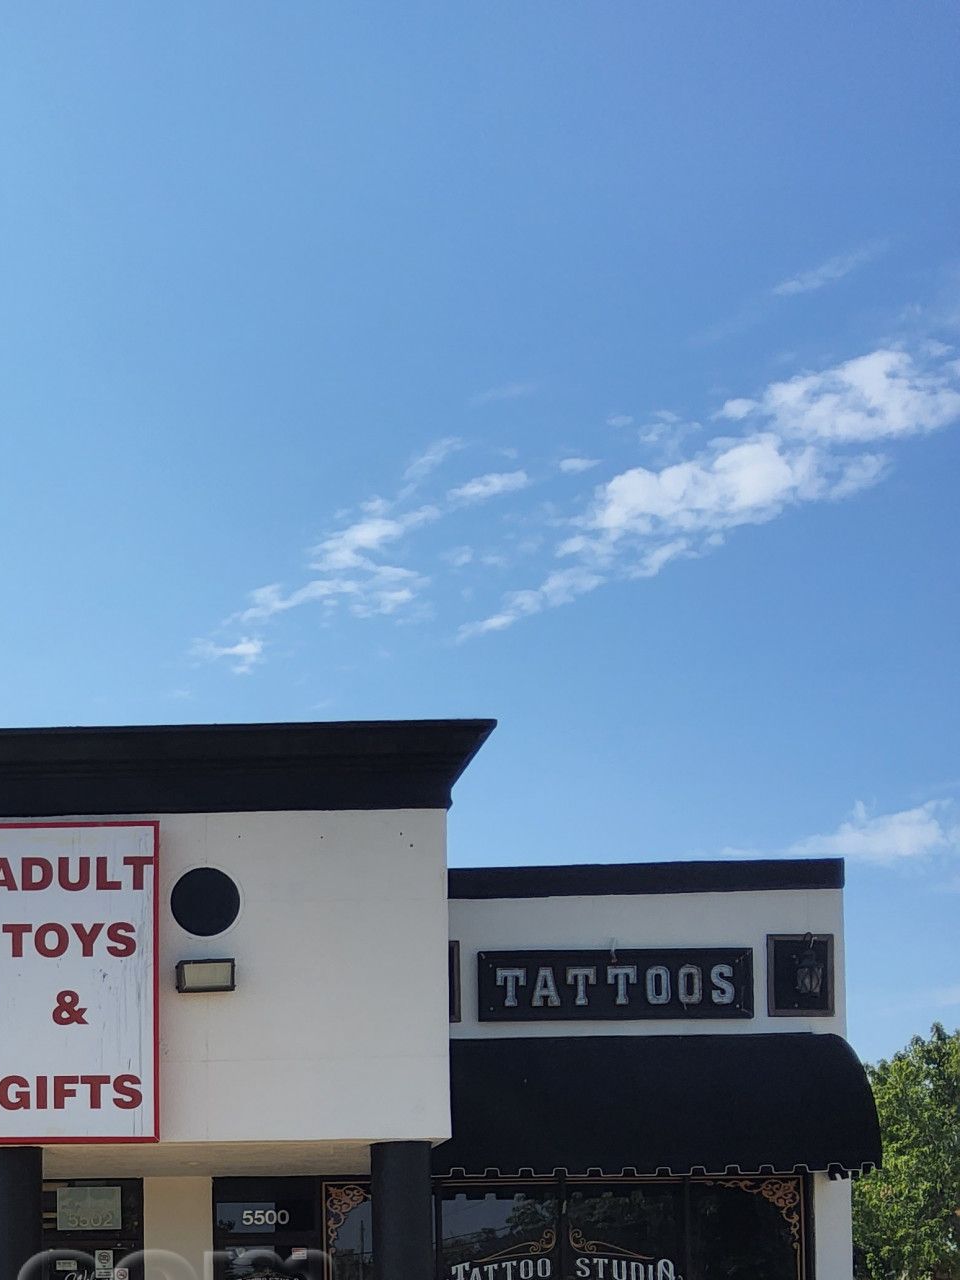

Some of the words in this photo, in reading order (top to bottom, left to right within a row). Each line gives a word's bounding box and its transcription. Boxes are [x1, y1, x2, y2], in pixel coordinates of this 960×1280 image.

[2, 922, 137, 957] TOYS
[496, 964, 736, 1006] TATTOOS
[52, 990, 89, 1025] &
[242, 1209, 290, 1226] 5500
